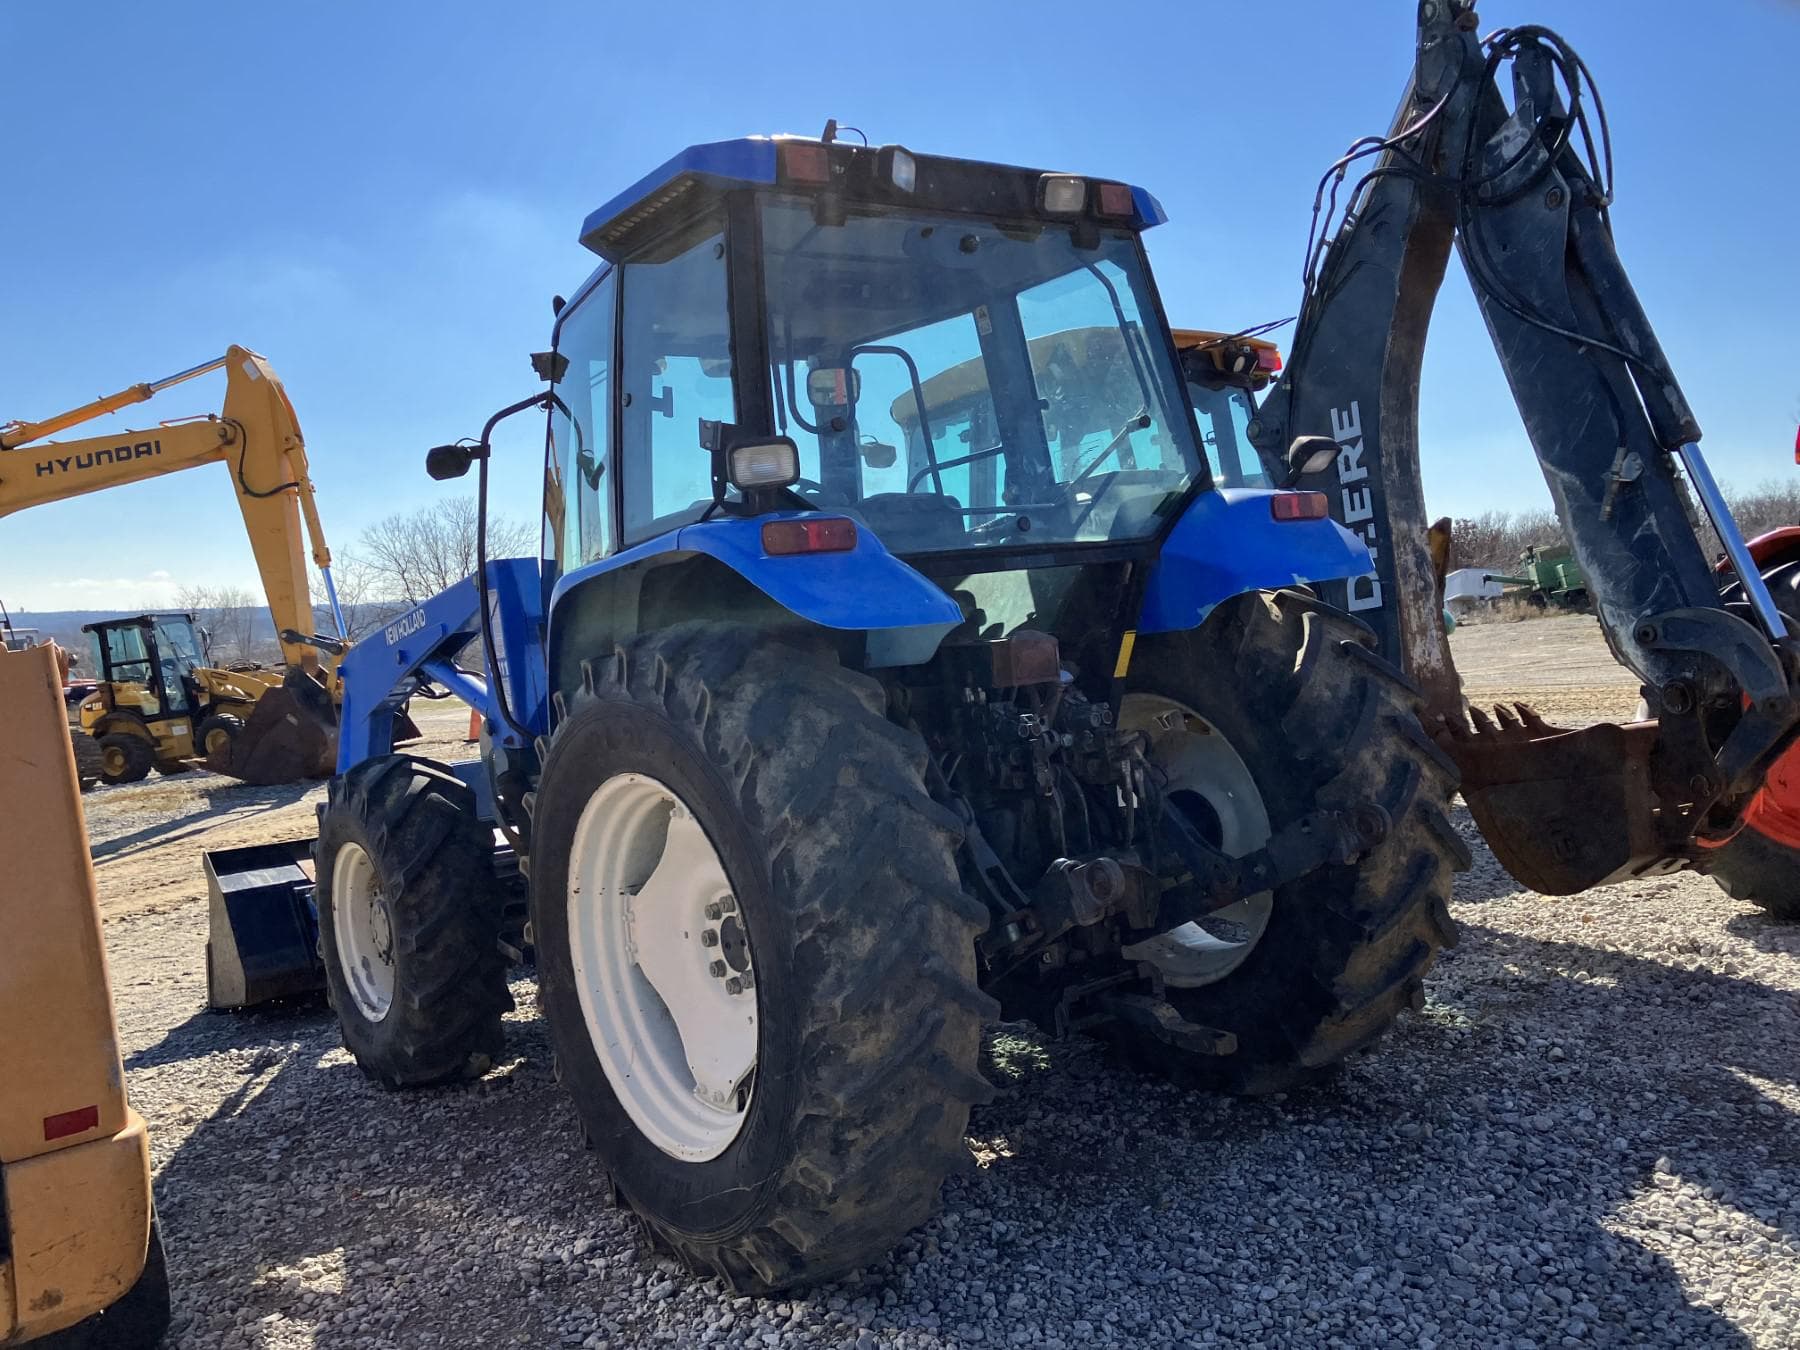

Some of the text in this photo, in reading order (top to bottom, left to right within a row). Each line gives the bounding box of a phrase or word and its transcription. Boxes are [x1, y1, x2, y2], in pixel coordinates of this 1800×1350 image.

[35, 440, 161, 477] HYUNDAI
[384, 608, 426, 647] NEW HOLLAND
